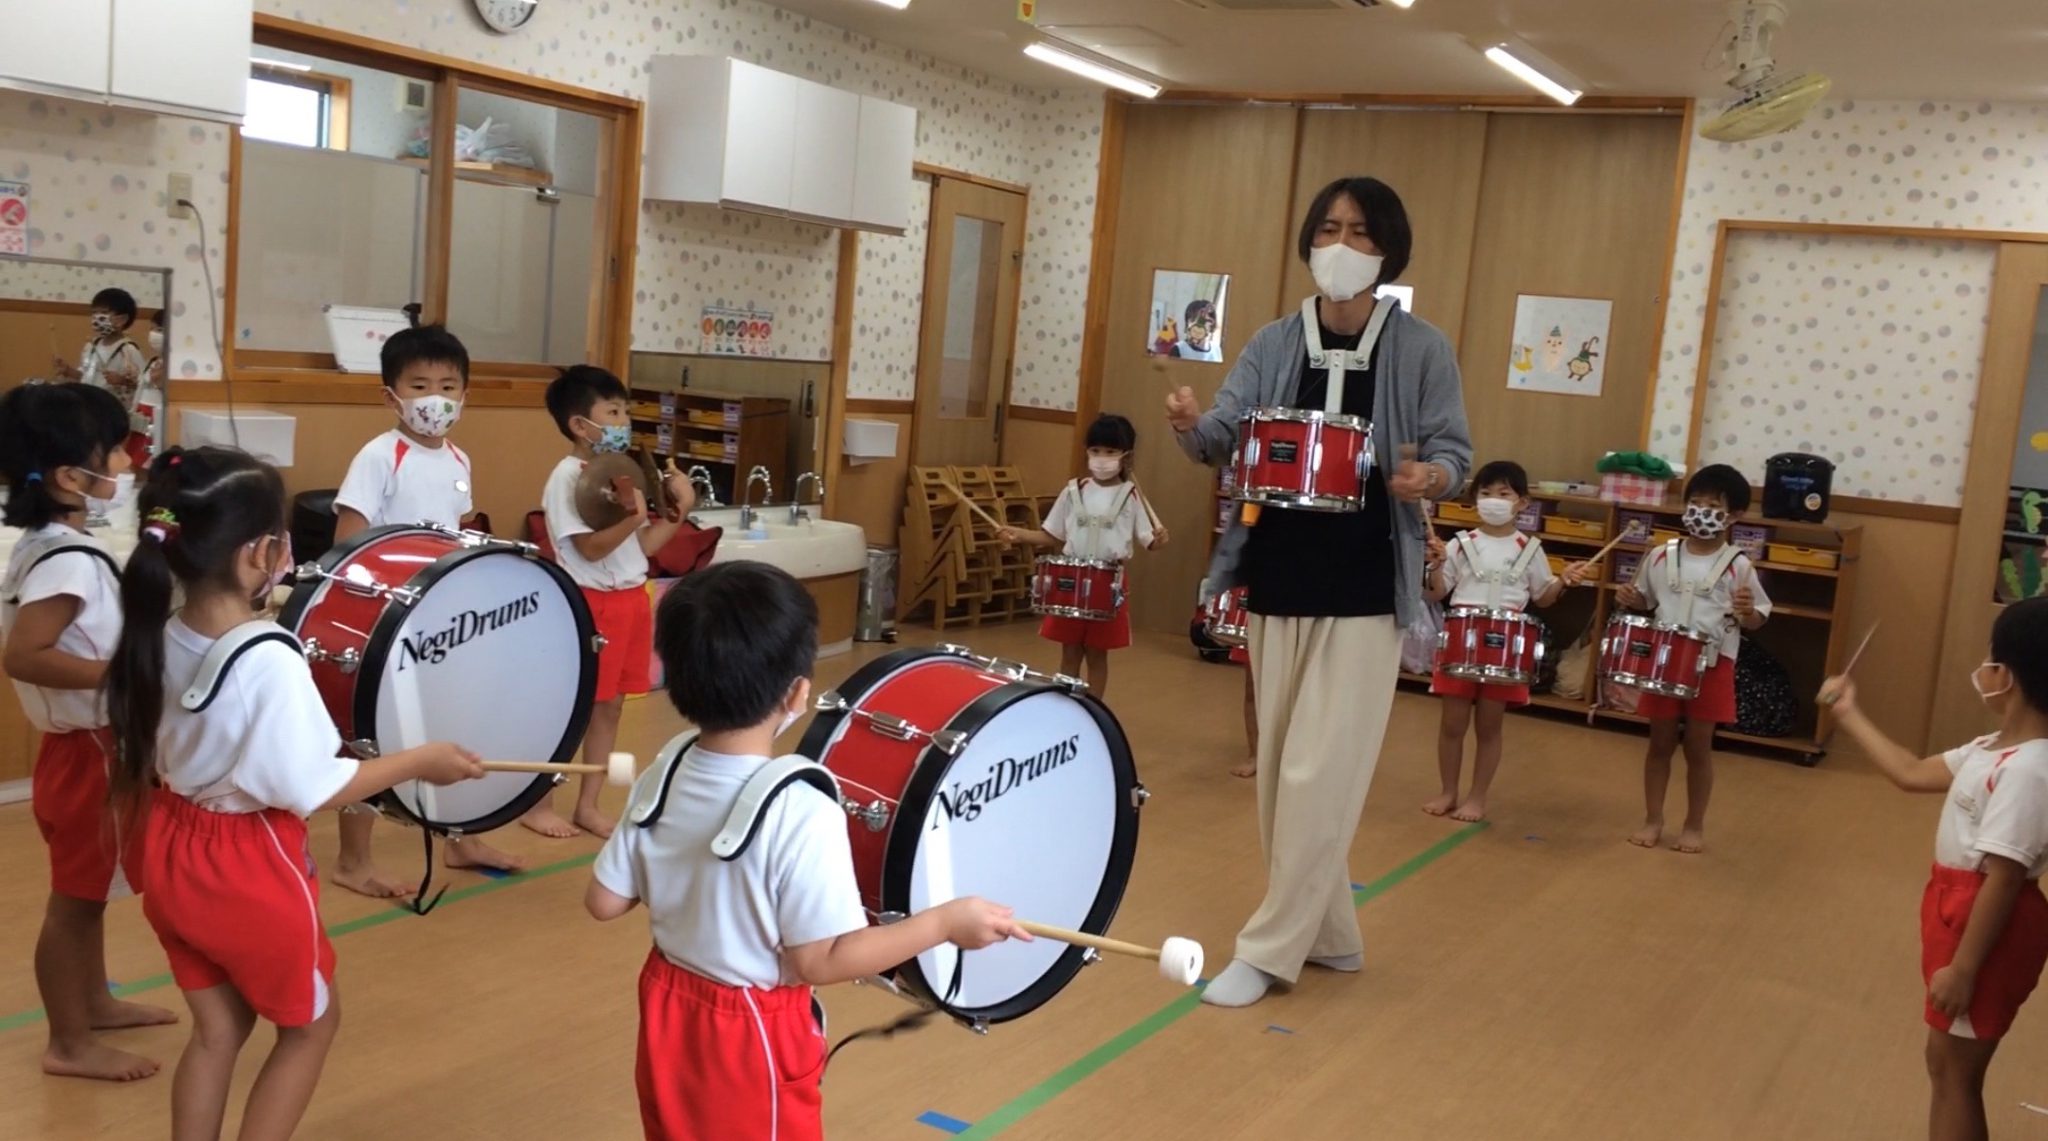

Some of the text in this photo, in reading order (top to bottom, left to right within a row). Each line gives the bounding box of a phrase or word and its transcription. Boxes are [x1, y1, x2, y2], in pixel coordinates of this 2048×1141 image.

[510, 6, 517, 22] 5
[397, 591, 540, 672] NegiDrums
[931, 734, 1079, 831] NegiDrums
